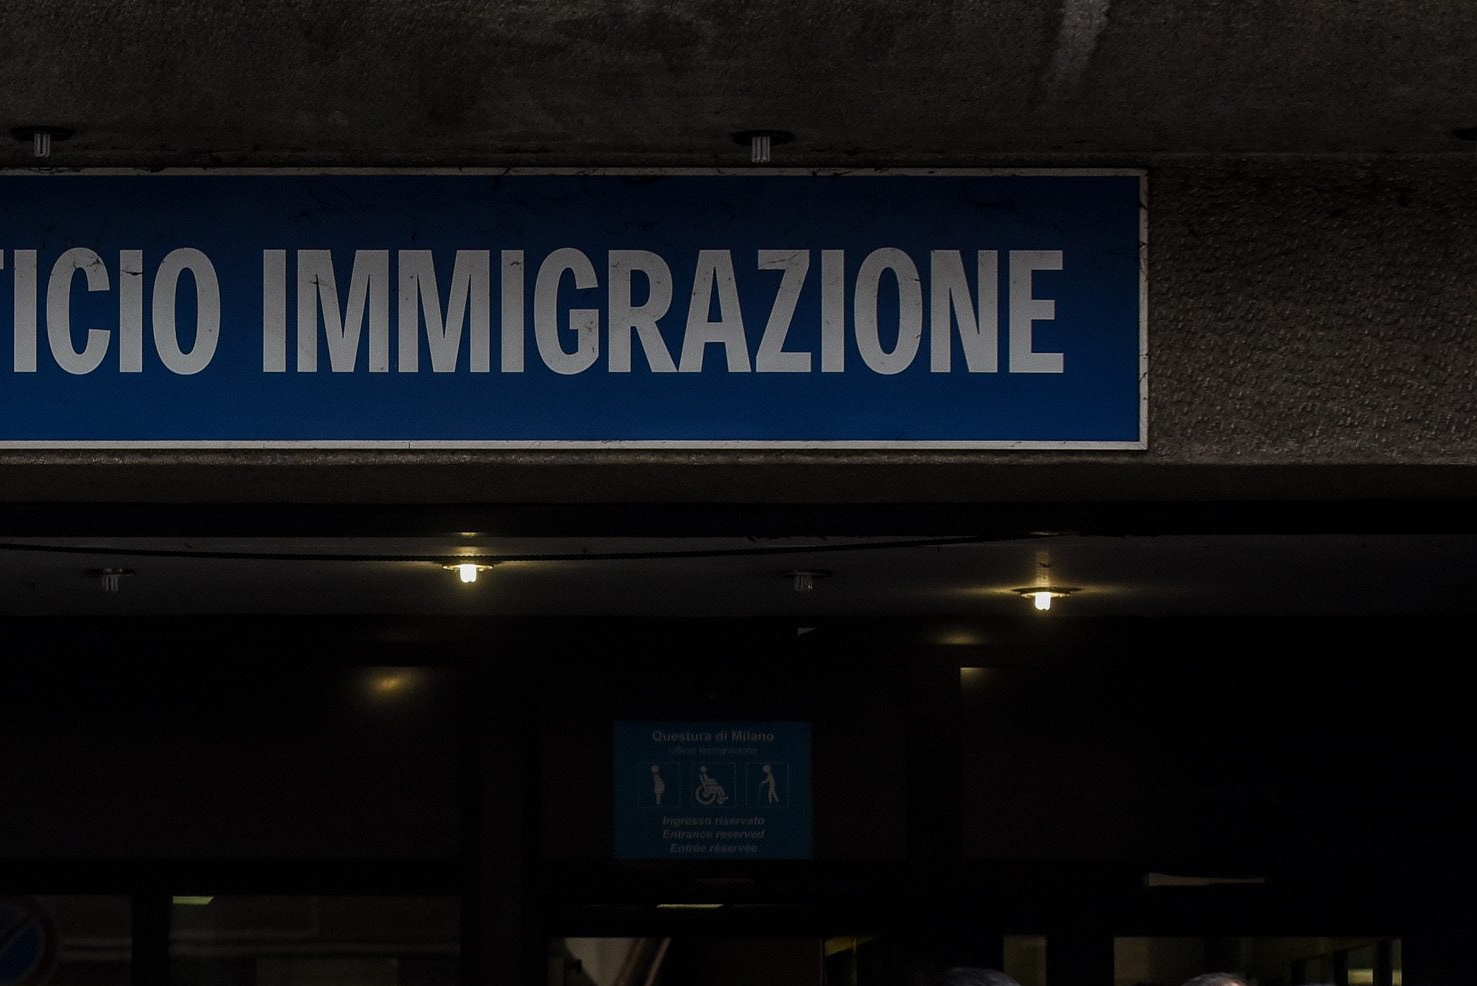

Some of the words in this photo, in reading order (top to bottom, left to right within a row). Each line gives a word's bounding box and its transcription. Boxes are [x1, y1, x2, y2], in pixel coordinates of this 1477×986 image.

[262, 247, 1065, 376] IMMIGRAZIONE
[652, 730, 711, 742] Questura
[715, 730, 728, 742] di
[731, 730, 775, 742] Milano
[662, 816, 711, 828] Ingresso
[715, 816, 765, 826] riservato
[662, 829, 713, 840] Entrance
[715, 829, 765, 840] reserved
